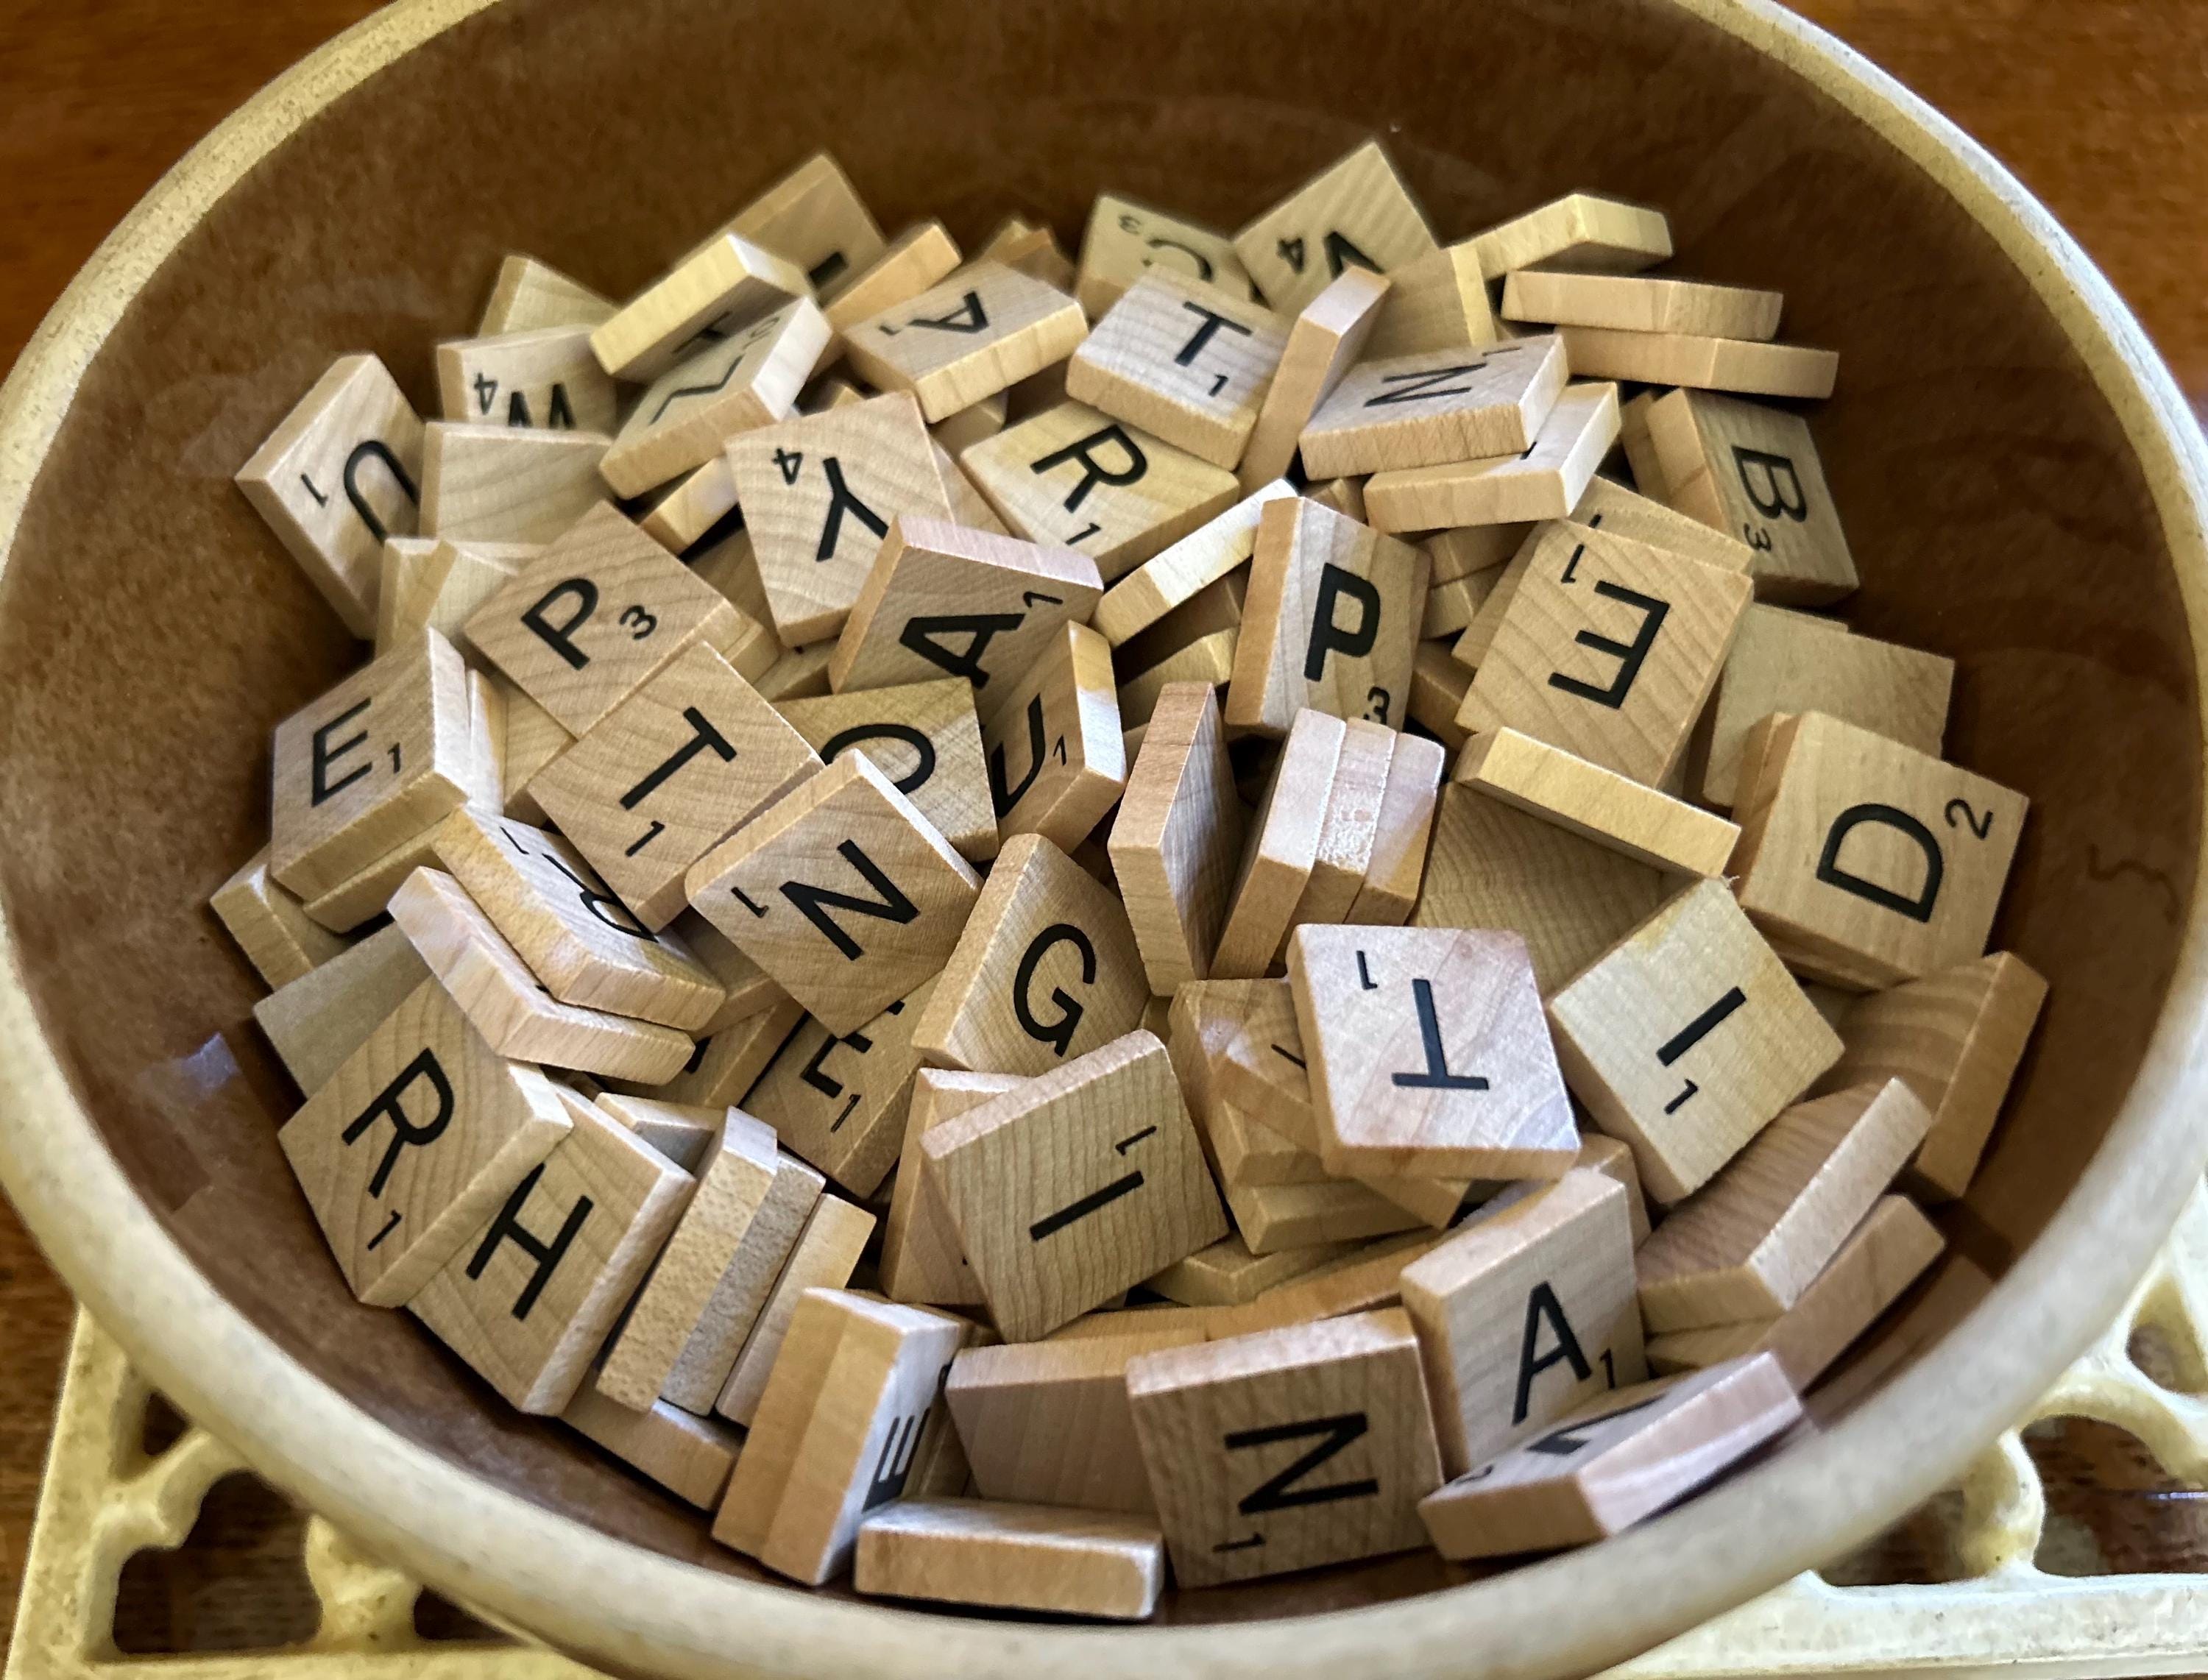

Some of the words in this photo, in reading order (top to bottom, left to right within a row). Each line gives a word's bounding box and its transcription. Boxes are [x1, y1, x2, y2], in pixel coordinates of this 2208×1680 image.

[1277, 238, 1305, 274] 4
[878, 323, 902, 336] 1
[908, 290, 989, 334] A
[1175, 300, 1253, 367] T
[473, 372, 498, 416] 4
[1208, 374, 1230, 398] 1
[1363, 362, 1487, 408] N
[300, 472, 329, 508] 1
[344, 440, 422, 547] U
[772, 447, 804, 486] 4
[1030, 424, 1148, 514] R
[1730, 443, 1810, 524] B
[815, 456, 891, 562] Y
[1064, 522, 1101, 547] 1
[1743, 520, 1774, 554] 3
[1560, 543, 1588, 584] 1
[520, 577, 600, 671] P
[618, 604, 658, 641] 3
[899, 613, 1026, 690] A
[1022, 590, 1064, 609] 1
[1303, 561, 1381, 683] P
[1362, 686, 1391, 726] 3
[1547, 578, 1671, 707] E
[311, 697, 372, 809] E
[386, 742, 403, 774] 1
[619, 706, 737, 811] T
[1052, 734, 1067, 767] 1
[499, 825, 531, 856] 1
[625, 820, 666, 858] 1
[1816, 802, 1943, 924] D
[1944, 797, 1995, 841] 2
[542, 852, 660, 944] R
[730, 885, 771, 919] 1
[778, 838, 921, 962] N
[1013, 923, 1097, 1058] G
[1356, 949, 1379, 990] 1
[1391, 977, 1490, 1091] T
[1656, 985, 1748, 1068] I
[341, 1046, 456, 1200] R
[830, 1093, 862, 1134] 1
[1663, 1077, 1699, 1116] 1
[1030, 1169, 1145, 1242] I
[1114, 1124, 1158, 1157] 1
[367, 1208, 403, 1252] 1
[465, 1161, 595, 1322] H
[1512, 1280, 1593, 1427] A
[1599, 1348, 1617, 1391] 1
[1223, 1410, 1379, 1517] N
[1211, 1532, 1267, 1554] 1
